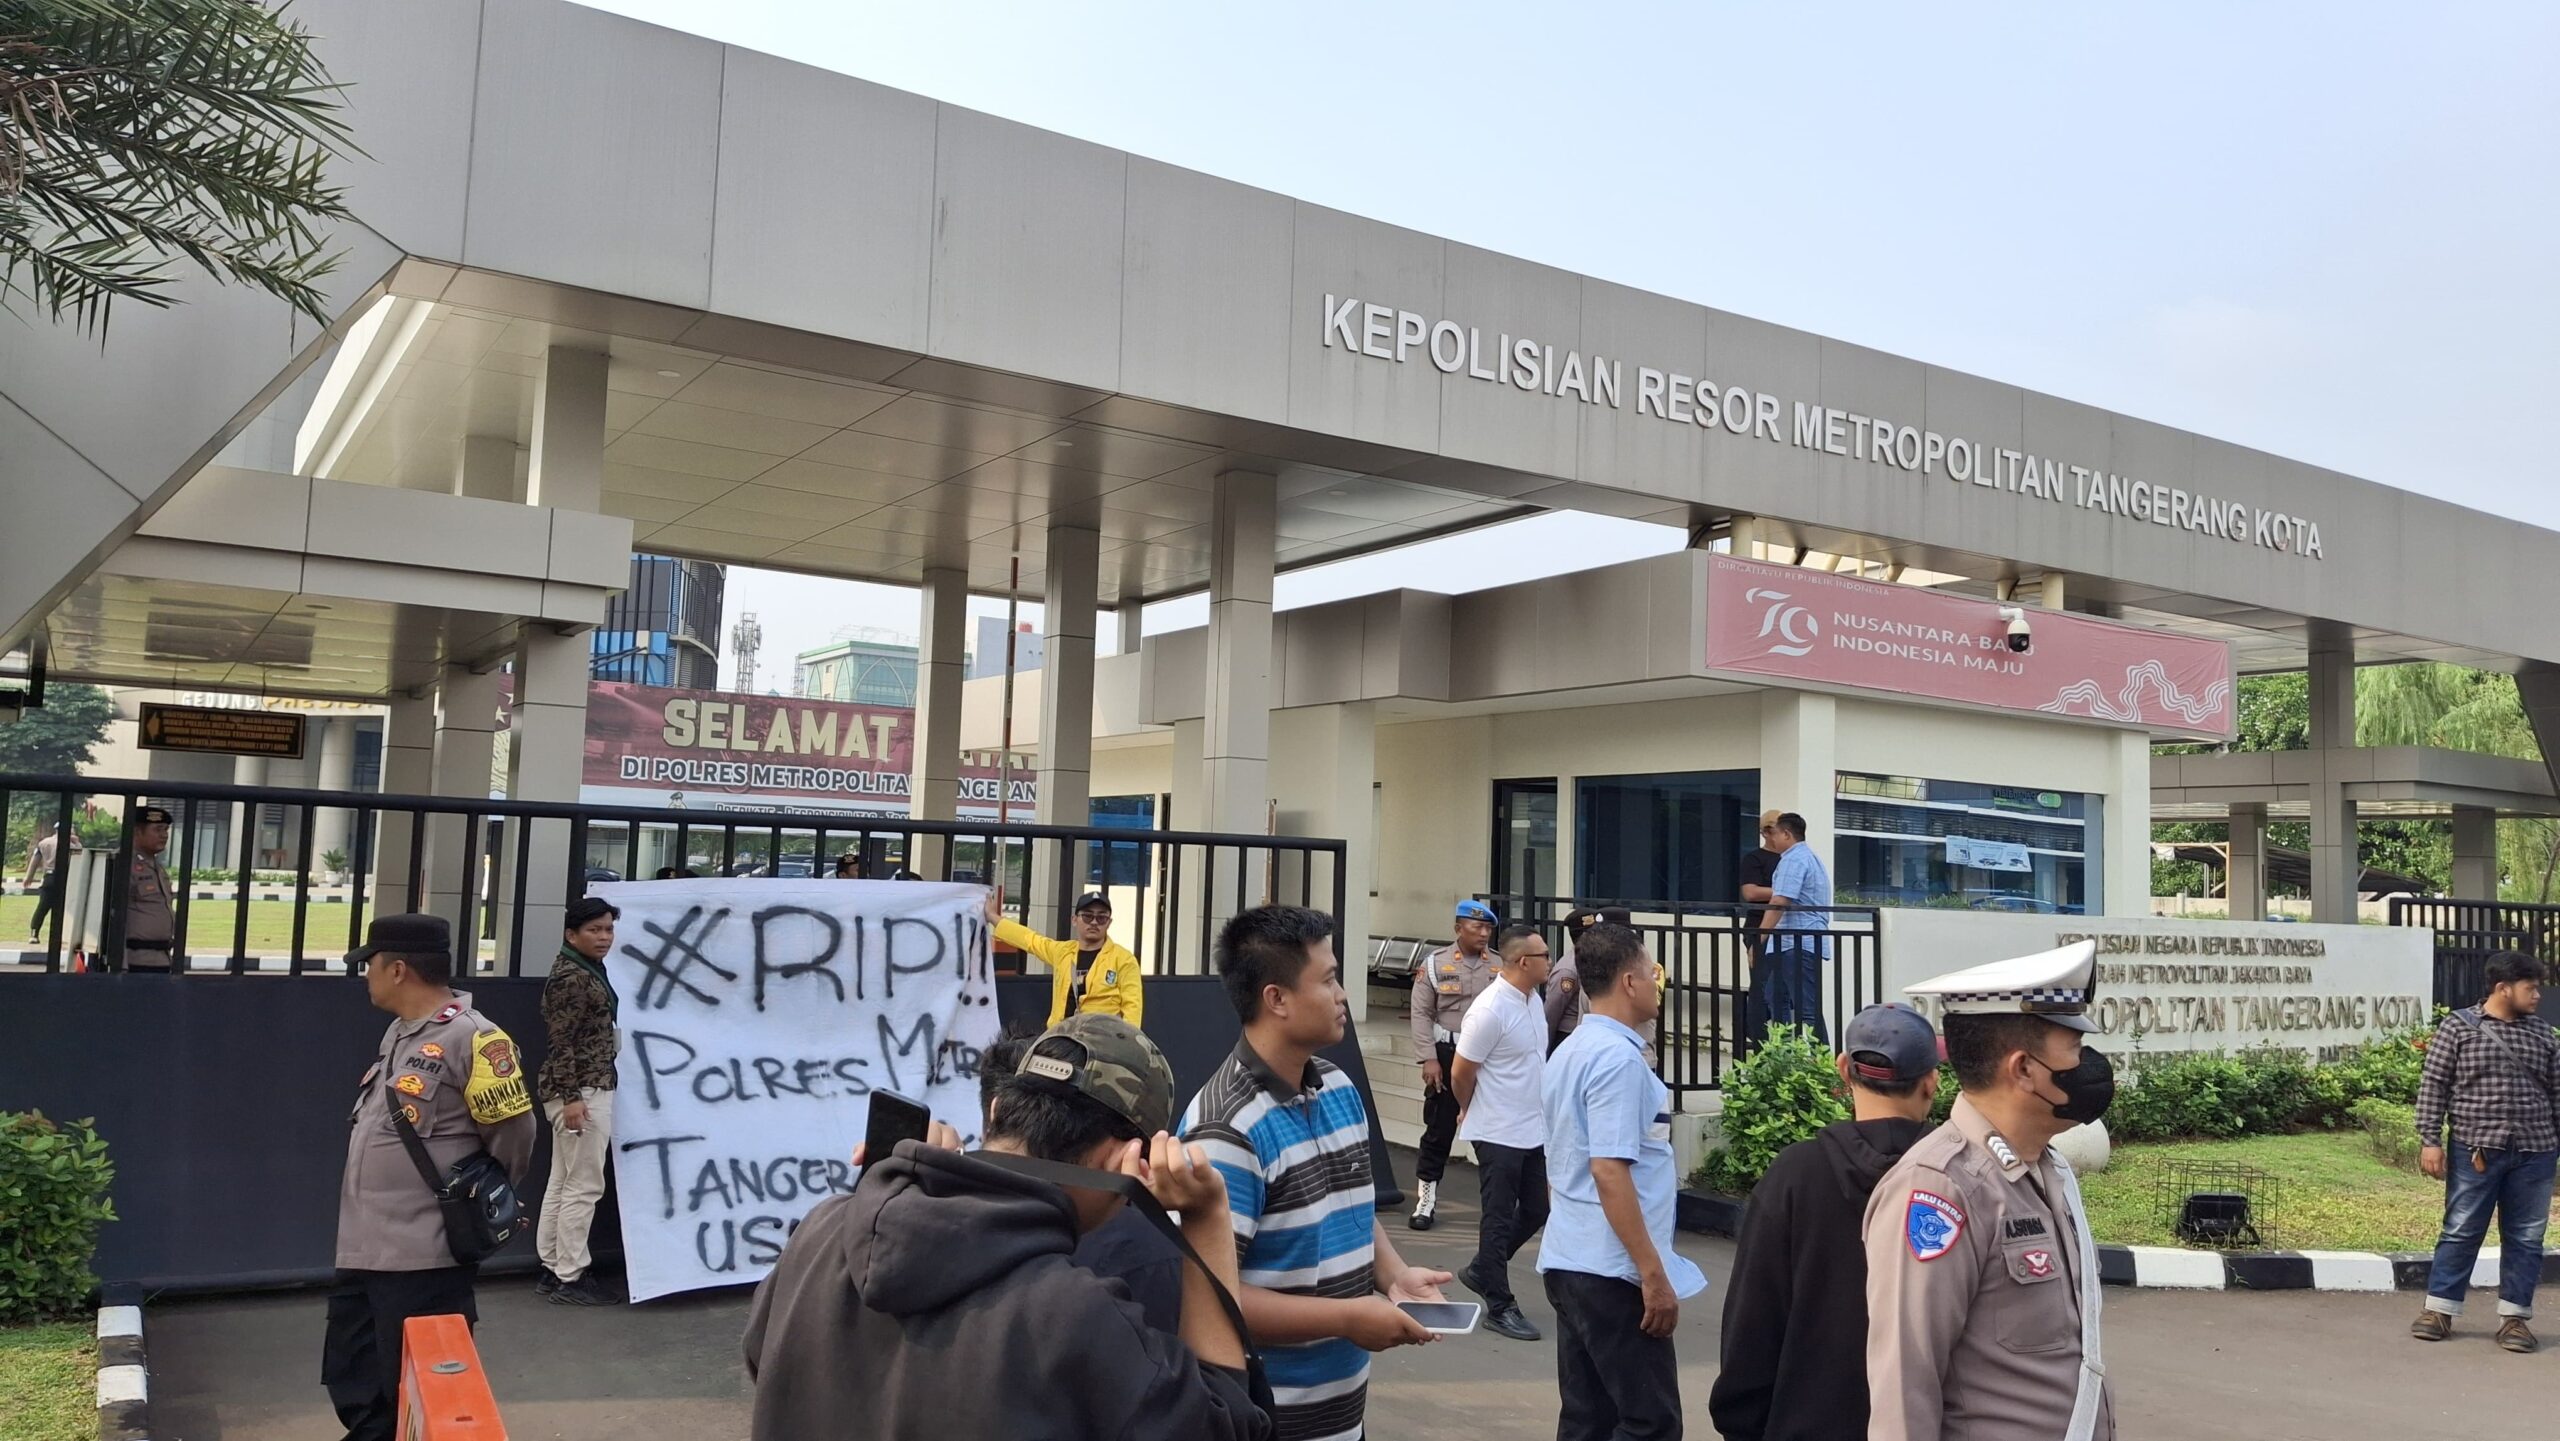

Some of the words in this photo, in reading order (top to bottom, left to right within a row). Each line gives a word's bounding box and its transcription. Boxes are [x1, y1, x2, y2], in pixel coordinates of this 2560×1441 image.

[1323, 292, 1622, 409] KEPOLISIAN
[1637, 365, 1782, 443] RESOR
[1792, 399, 2065, 503] METROPOLITAN
[2069, 463, 2248, 542] TANGERANG
[2253, 506, 2324, 561] KOTA
[1784, 571, 1834, 588] REPUBLIK
[1836, 578, 1890, 597] INDONESIA
[1833, 611, 1972, 648] NUSANTARA
[1979, 635, 2035, 657] BAU
[1833, 633, 1957, 666] INDONESIA
[1963, 656, 2025, 676] MAJU
[662, 697, 899, 762] SELAMAT
[621, 756, 649, 780] DI
[653, 758, 747, 786] POLRES
[752, 766, 912, 796] METROPOLITA
[2056, 933, 2141, 955] KELISIAN
[2143, 934, 2198, 955] NEGARA
[2201, 935, 2260, 957] REPUBLIK
[2261, 937, 2326, 958] INDONESIA
[2097, 963, 2126, 984] RAH
[2128, 963, 2229, 985] METROPOLITAN
[2230, 964, 2282, 985] JAKARTA
[2283, 966, 2313, 985] RAYA
[2087, 996, 2226, 1034] ROPOLITAN
[2232, 995, 2366, 1032] TANGERANG
[2371, 995, 2424, 1030] KOTA
[405, 1056, 443, 1075] POLRI
[631, 1030, 871, 1110] POLRES
[876, 1012, 983, 1092] METR
[621, 1135, 855, 1220] TANGER
[1913, 1192, 1937, 1205] LALU
[1936, 1199, 1963, 1222] LINTAS
[695, 1215, 799, 1273] US
